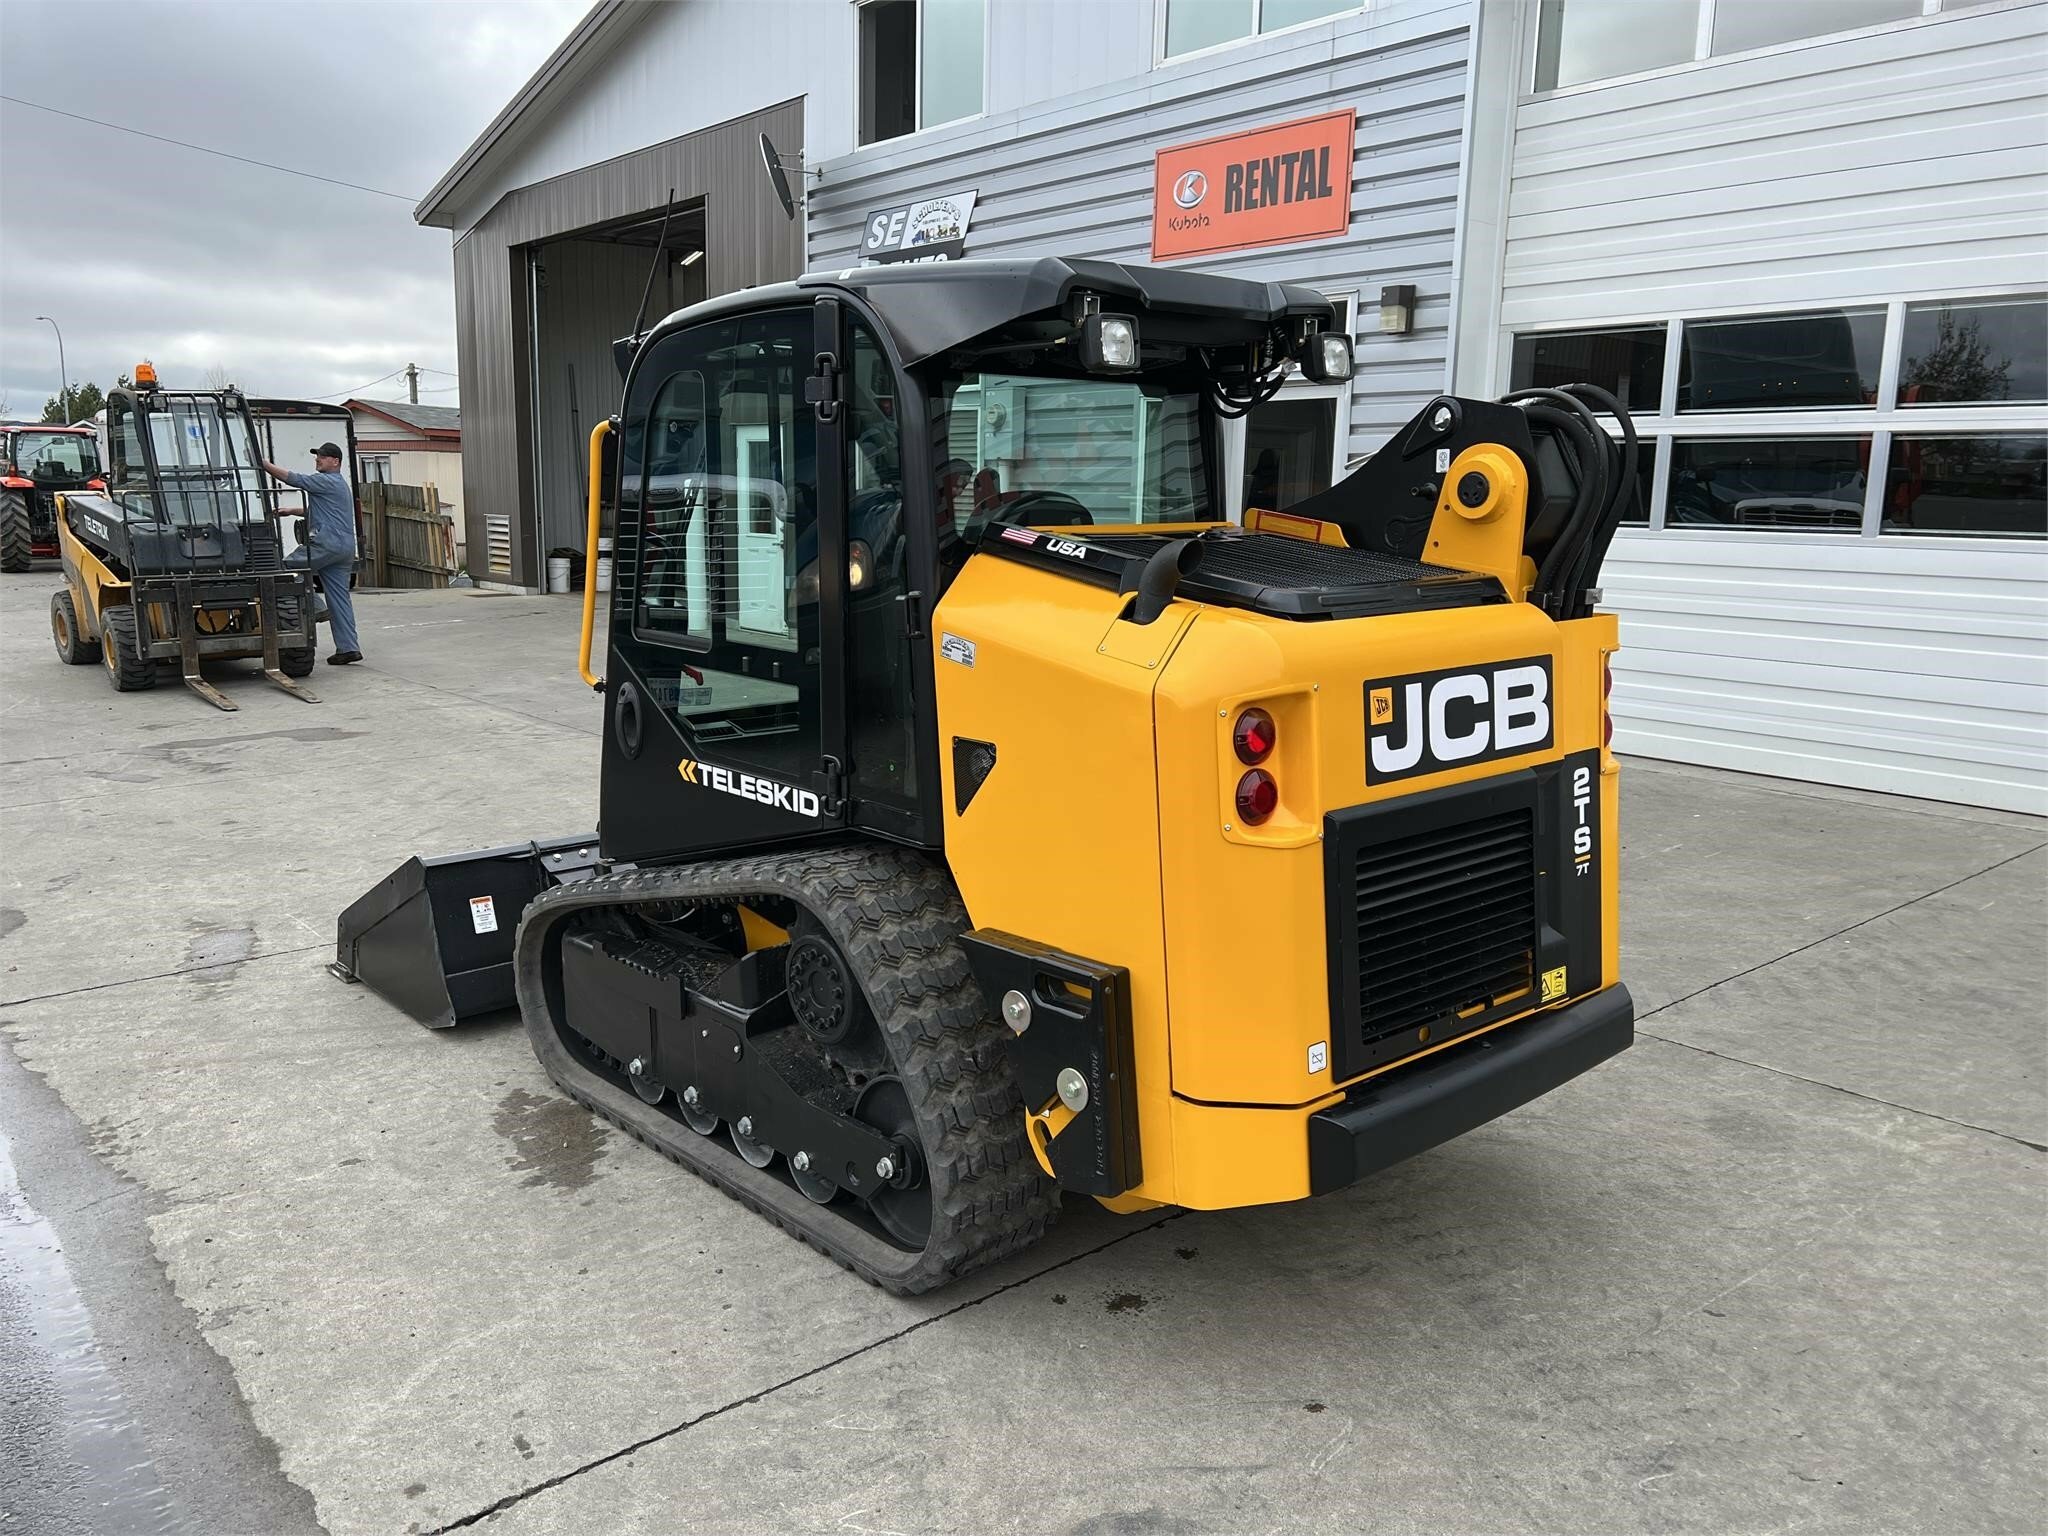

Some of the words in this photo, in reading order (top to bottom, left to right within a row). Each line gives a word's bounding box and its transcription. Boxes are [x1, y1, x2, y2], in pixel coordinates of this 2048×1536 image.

[1224, 145, 1333, 214] RENTAL
[867, 211, 907, 249] SE
[1169, 213, 1210, 231] Kubota
[1046, 538, 1087, 559] USA
[1371, 665, 1550, 773] JCB
[1376, 698, 1389, 715] JCB
[697, 762, 819, 818] TELESKID
[1573, 766, 1592, 855] 2TS
[1576, 862, 1590, 877] 7T
